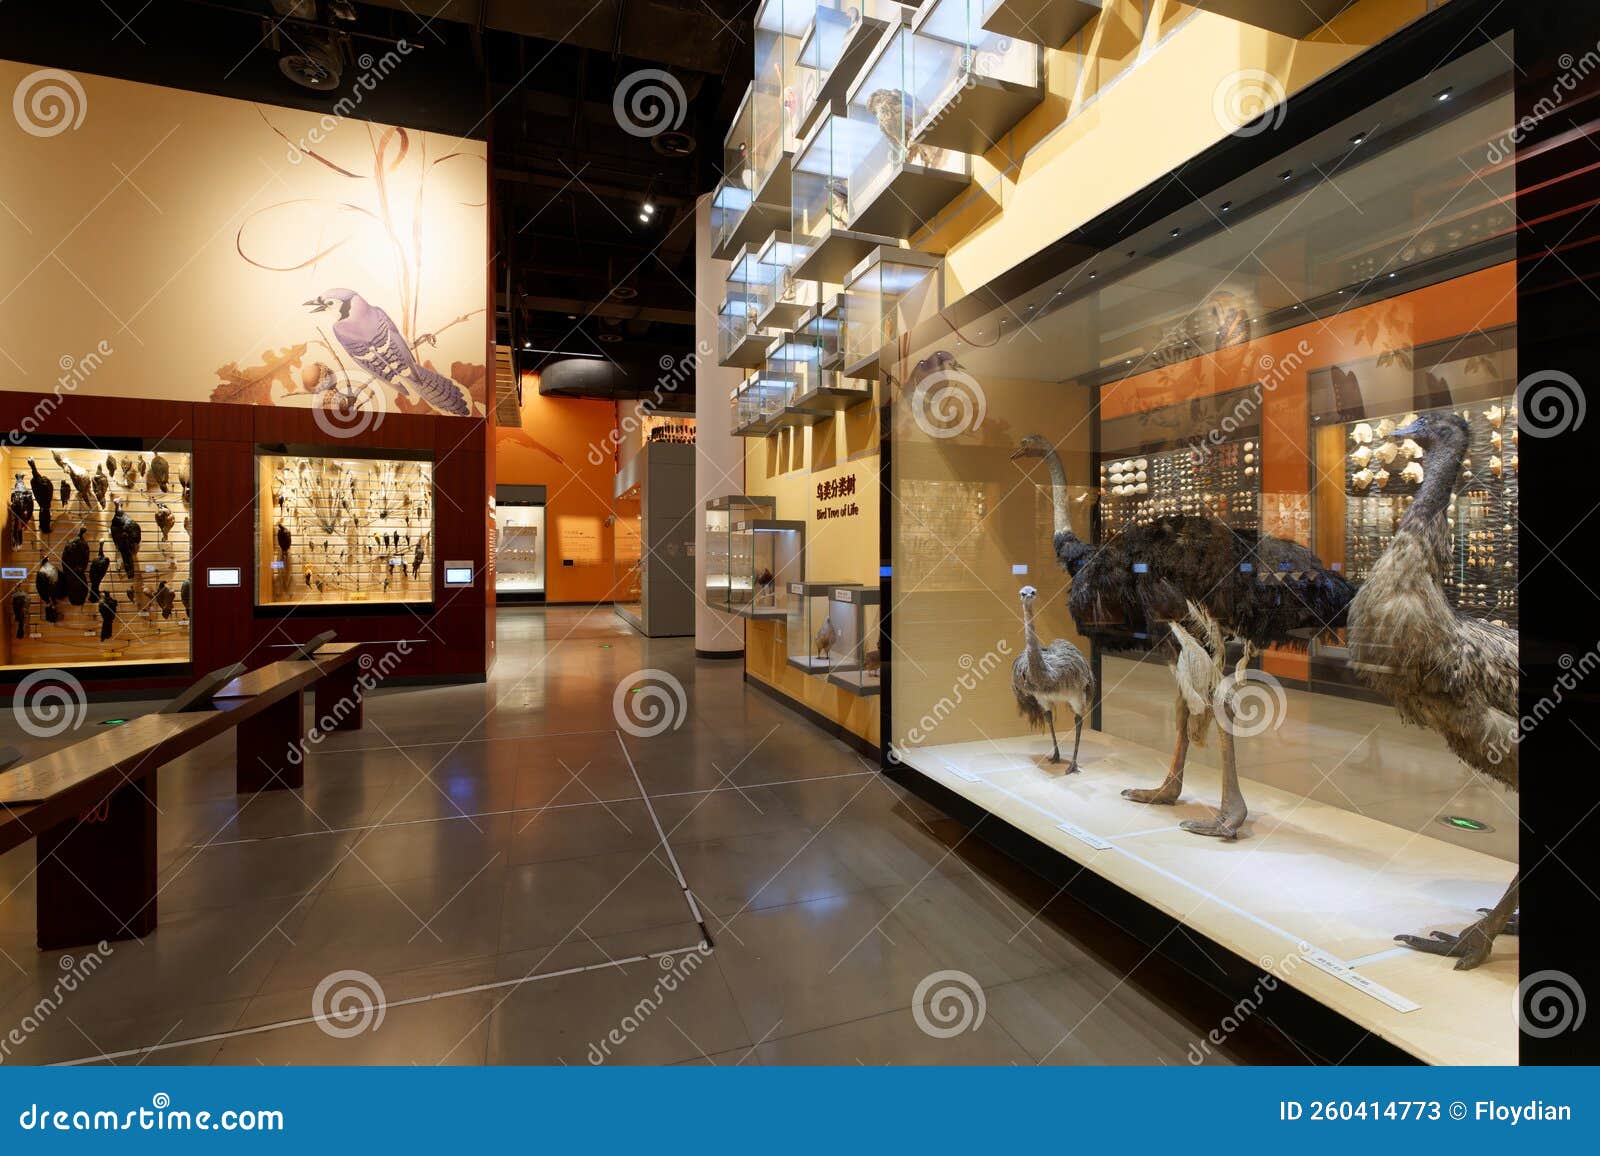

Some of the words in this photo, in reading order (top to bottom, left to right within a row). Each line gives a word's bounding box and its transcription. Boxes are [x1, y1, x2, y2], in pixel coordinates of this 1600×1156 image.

[816, 507, 827, 520] Bird
[827, 507, 840, 518] Tree
[847, 502, 859, 516] Life
